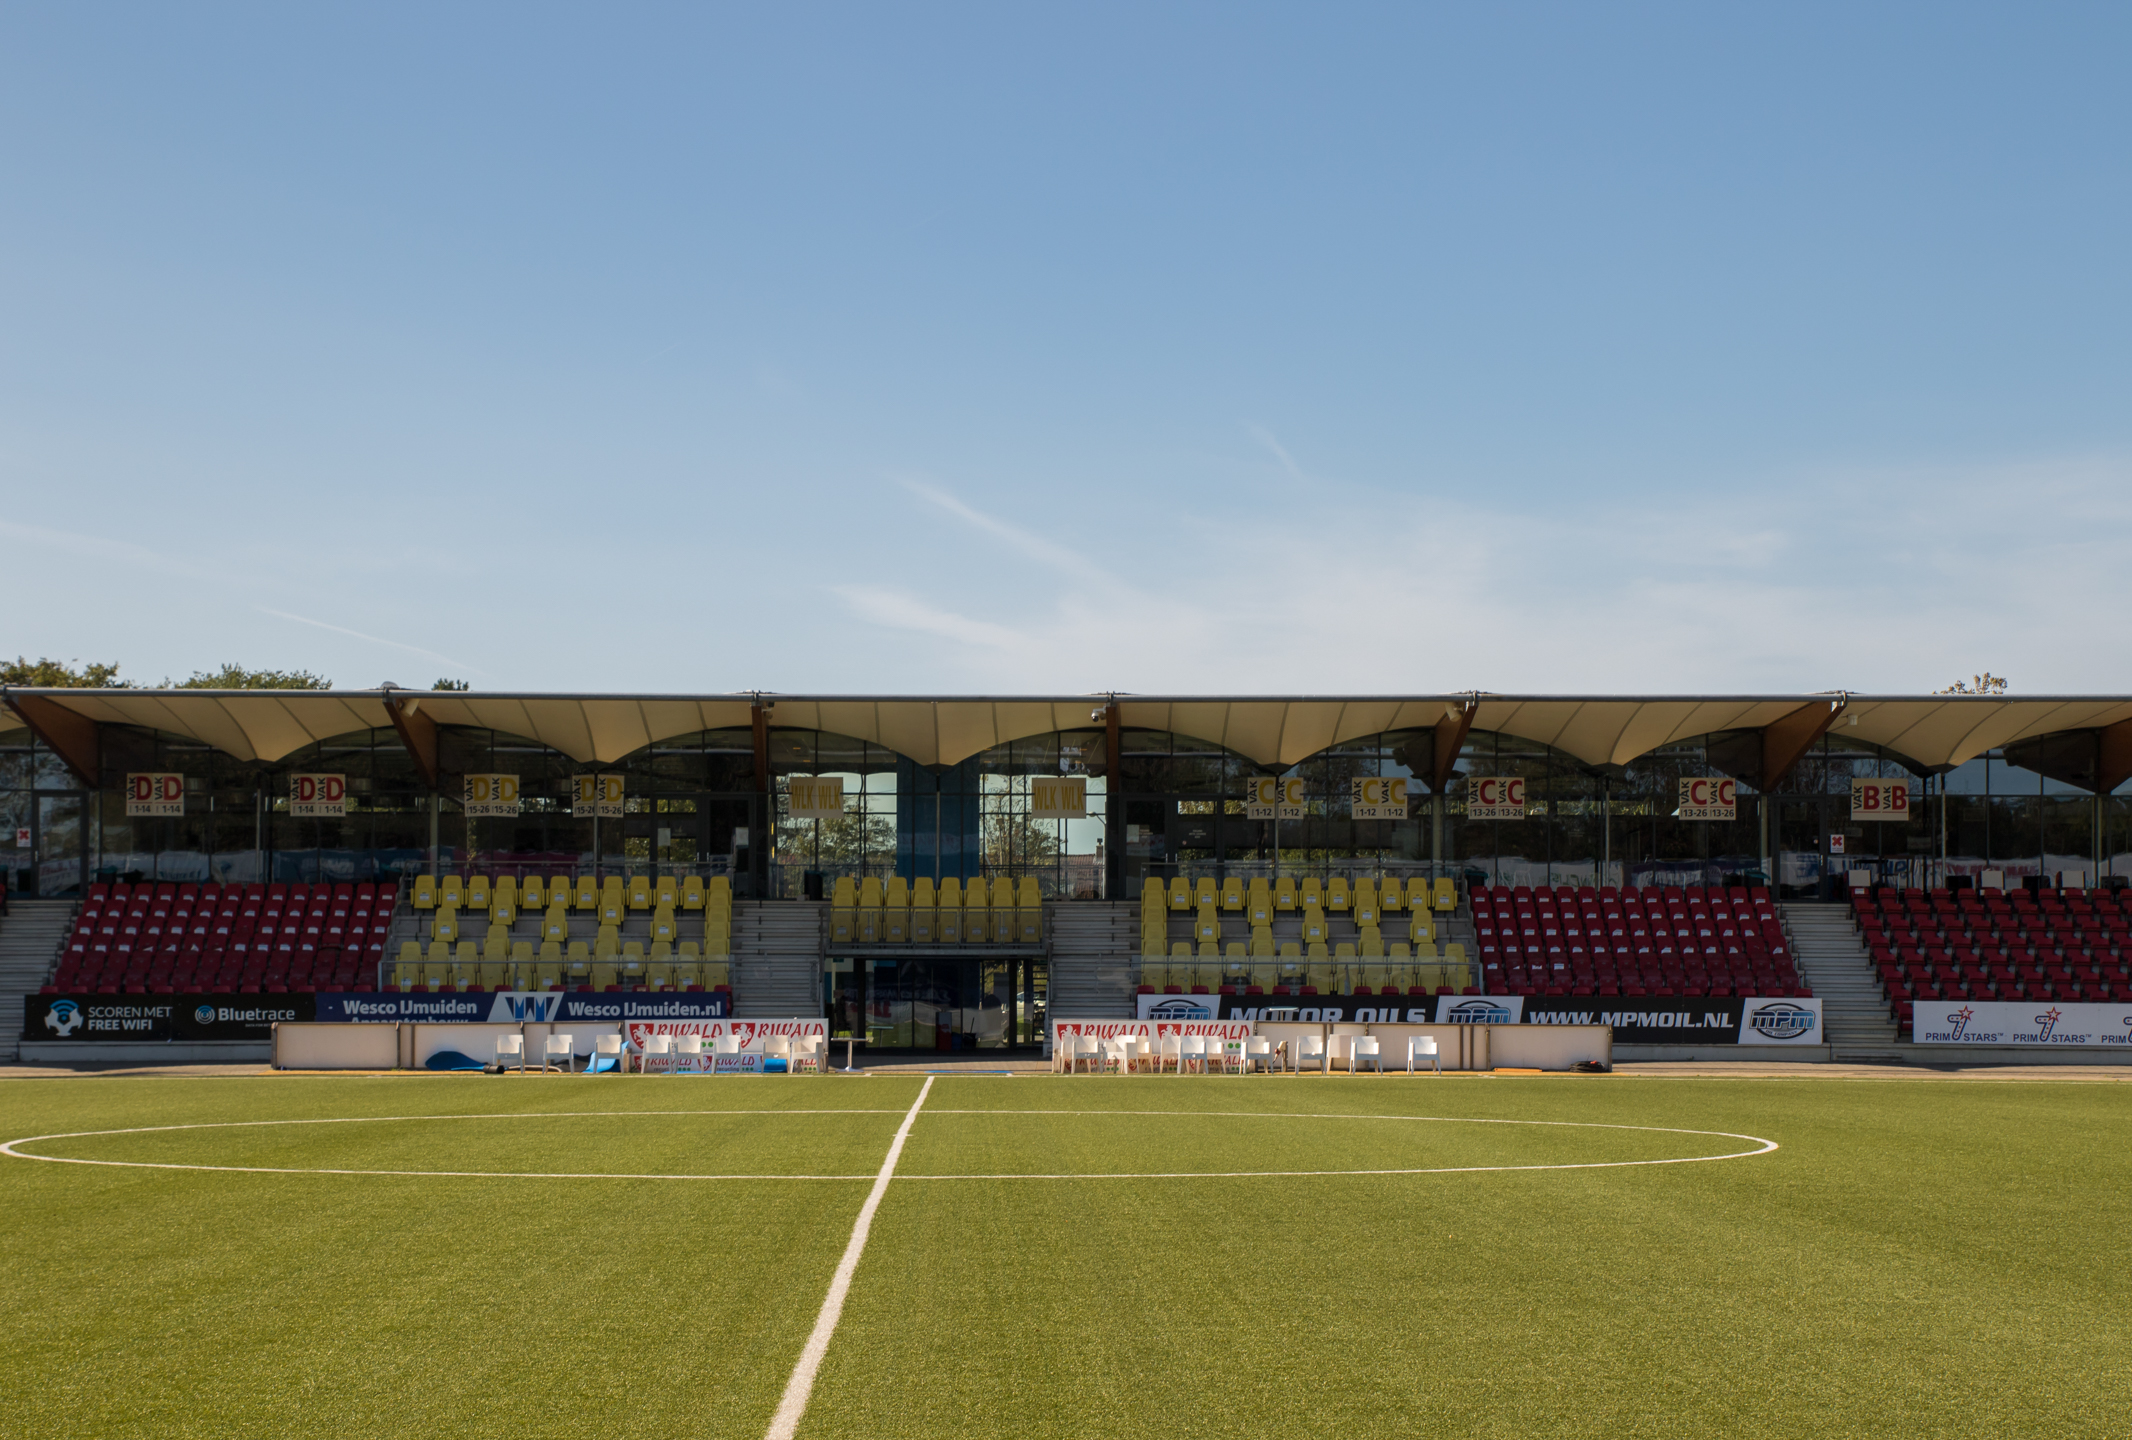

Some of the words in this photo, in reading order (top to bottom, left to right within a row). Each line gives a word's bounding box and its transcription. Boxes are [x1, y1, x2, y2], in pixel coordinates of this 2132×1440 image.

[136, 776, 152, 800] D
[164, 776, 182, 800] D
[300, 777, 316, 801] D
[326, 777, 344, 801] D
[474, 777, 489, 801] D
[500, 777, 517, 801] D
[582, 778, 595, 802] D
[606, 778, 623, 802] D
[1034, 786, 1057, 810] WLK
[1062, 786, 1084, 810] WLK
[1259, 780, 1274, 804] C
[1286, 780, 1302, 804] C
[1363, 780, 1378, 804] C
[1390, 780, 1405, 804] C
[1480, 780, 1496, 804] C
[1508, 780, 1523, 804] C
[1681, 781, 1689, 804] VAK
[1691, 780, 1707, 805] C
[1719, 780, 1733, 805] C
[1853, 786, 1862, 810] VAK
[1863, 786, 1880, 810] B
[1892, 786, 1907, 810] B
[601, 806, 622, 814] 15-26
[88, 1007, 142, 1017] SCOREN
[144, 1007, 172, 1017] MET
[218, 1007, 295, 1020] Bluetrace
[343, 1000, 396, 1014] Wesco
[568, 1002, 620, 1016] Wesco
[88, 1020, 119, 1030] FREE
[121, 1020, 152, 1030] WIFI
[657, 1023, 722, 1038] RIWALD
[758, 1023, 823, 1038] RIWALD
[1084, 1024, 1148, 1039] RIWALD
[1184, 1024, 1249, 1039] RIWALD
[1530, 1012, 1734, 1028] WWW.MPMOIL.NL
[1926, 1032, 1950, 1041] PRIM
[2013, 1033, 2038, 1042] PRIM
[2102, 1035, 2126, 1043] PRIM
